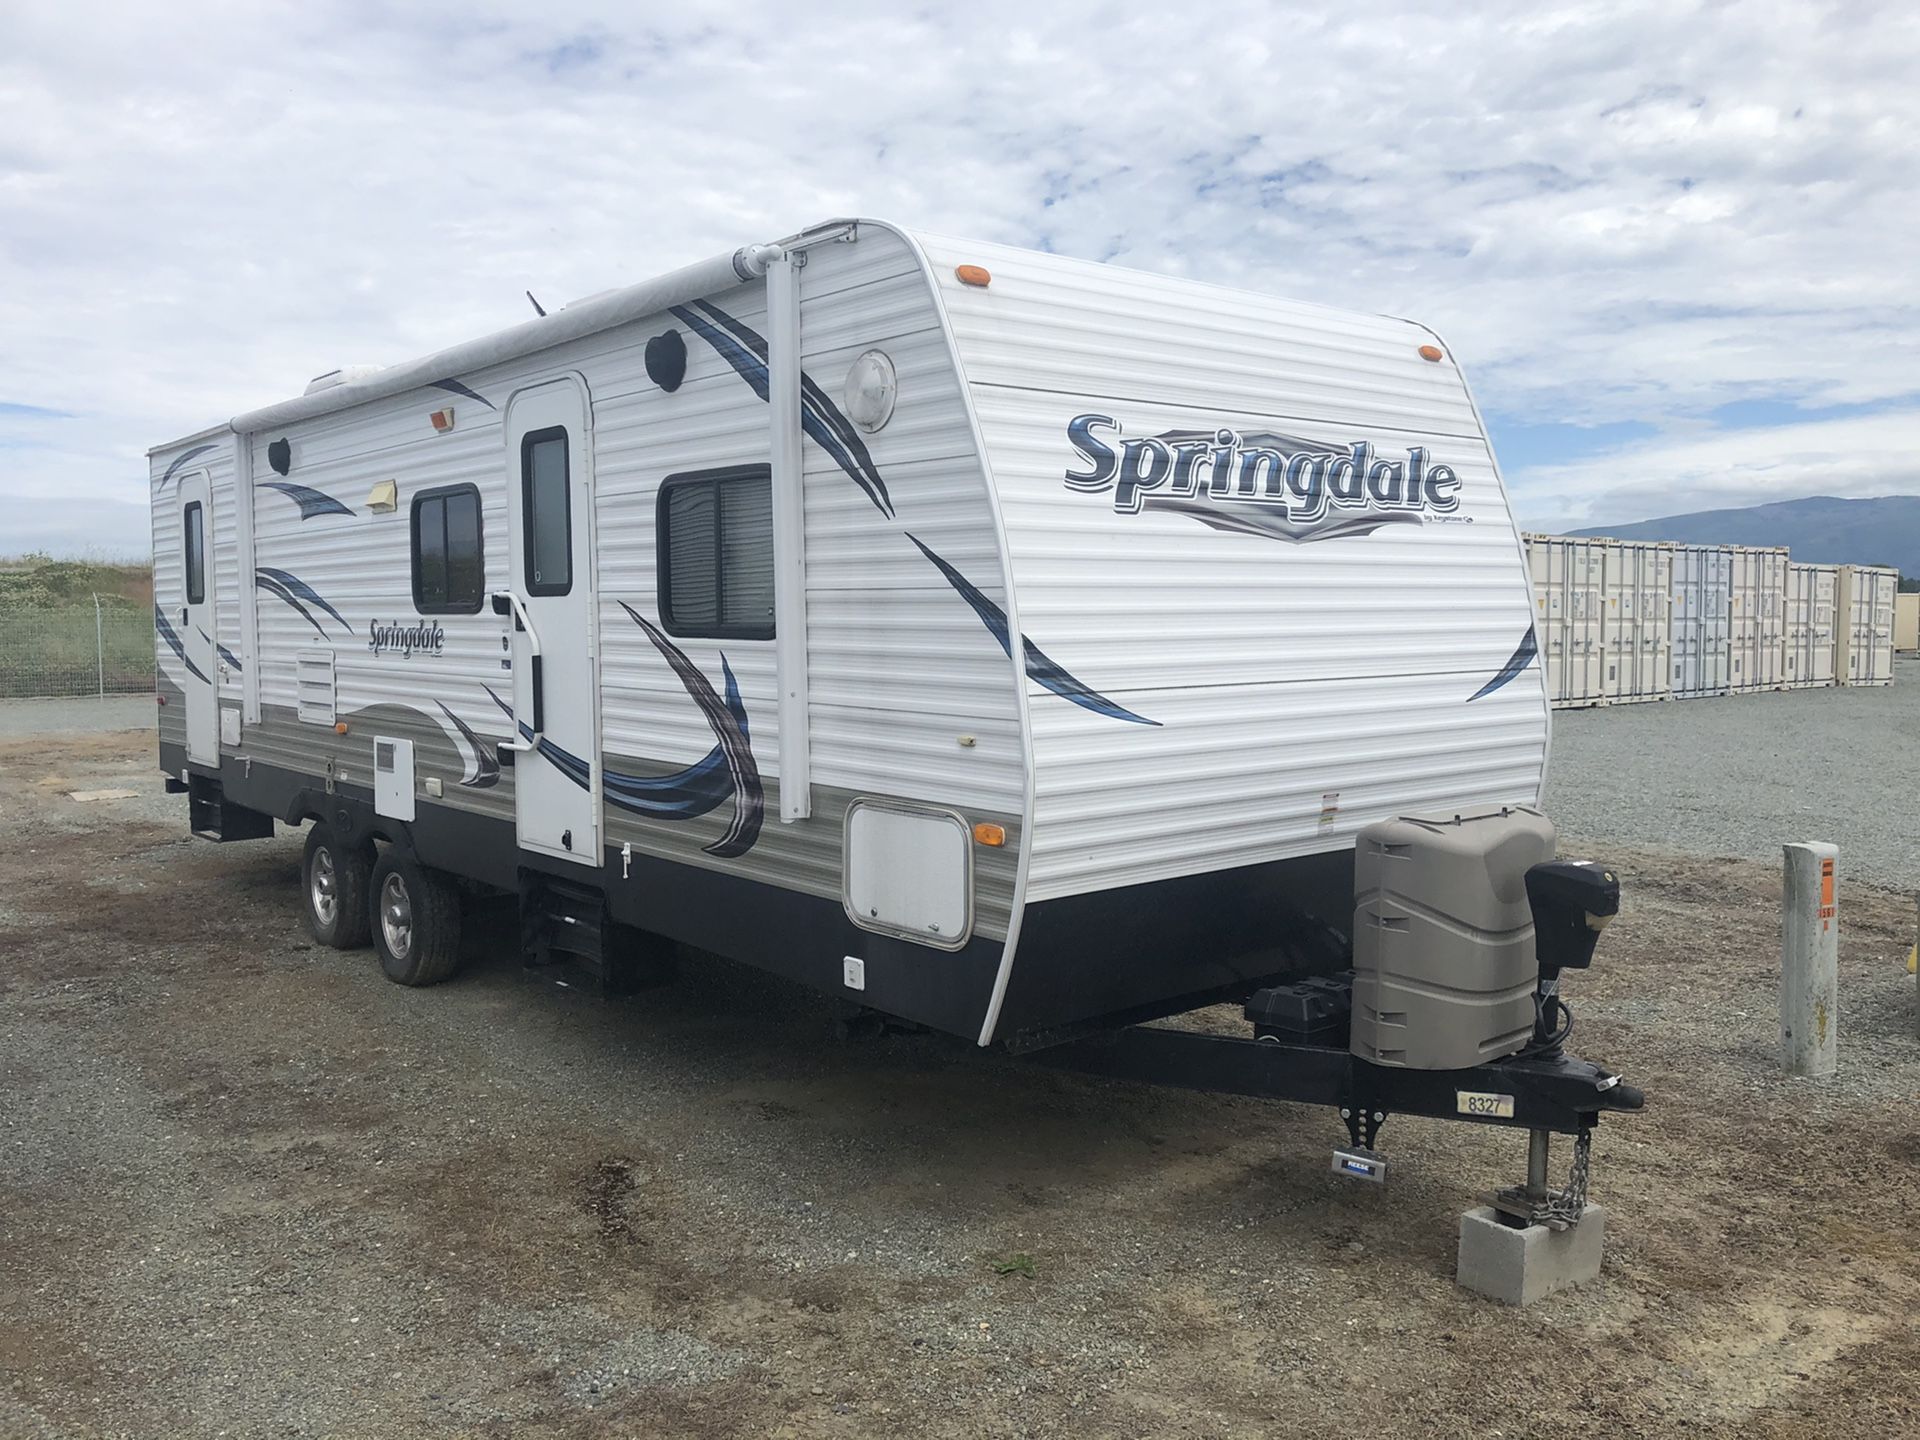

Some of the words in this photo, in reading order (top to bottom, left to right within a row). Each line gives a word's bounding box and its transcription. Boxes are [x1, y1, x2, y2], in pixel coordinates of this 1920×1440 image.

[1064, 413, 1462, 524] Springdale
[369, 618, 445, 659] Springdale
[1468, 1096, 1501, 1114] 8327
